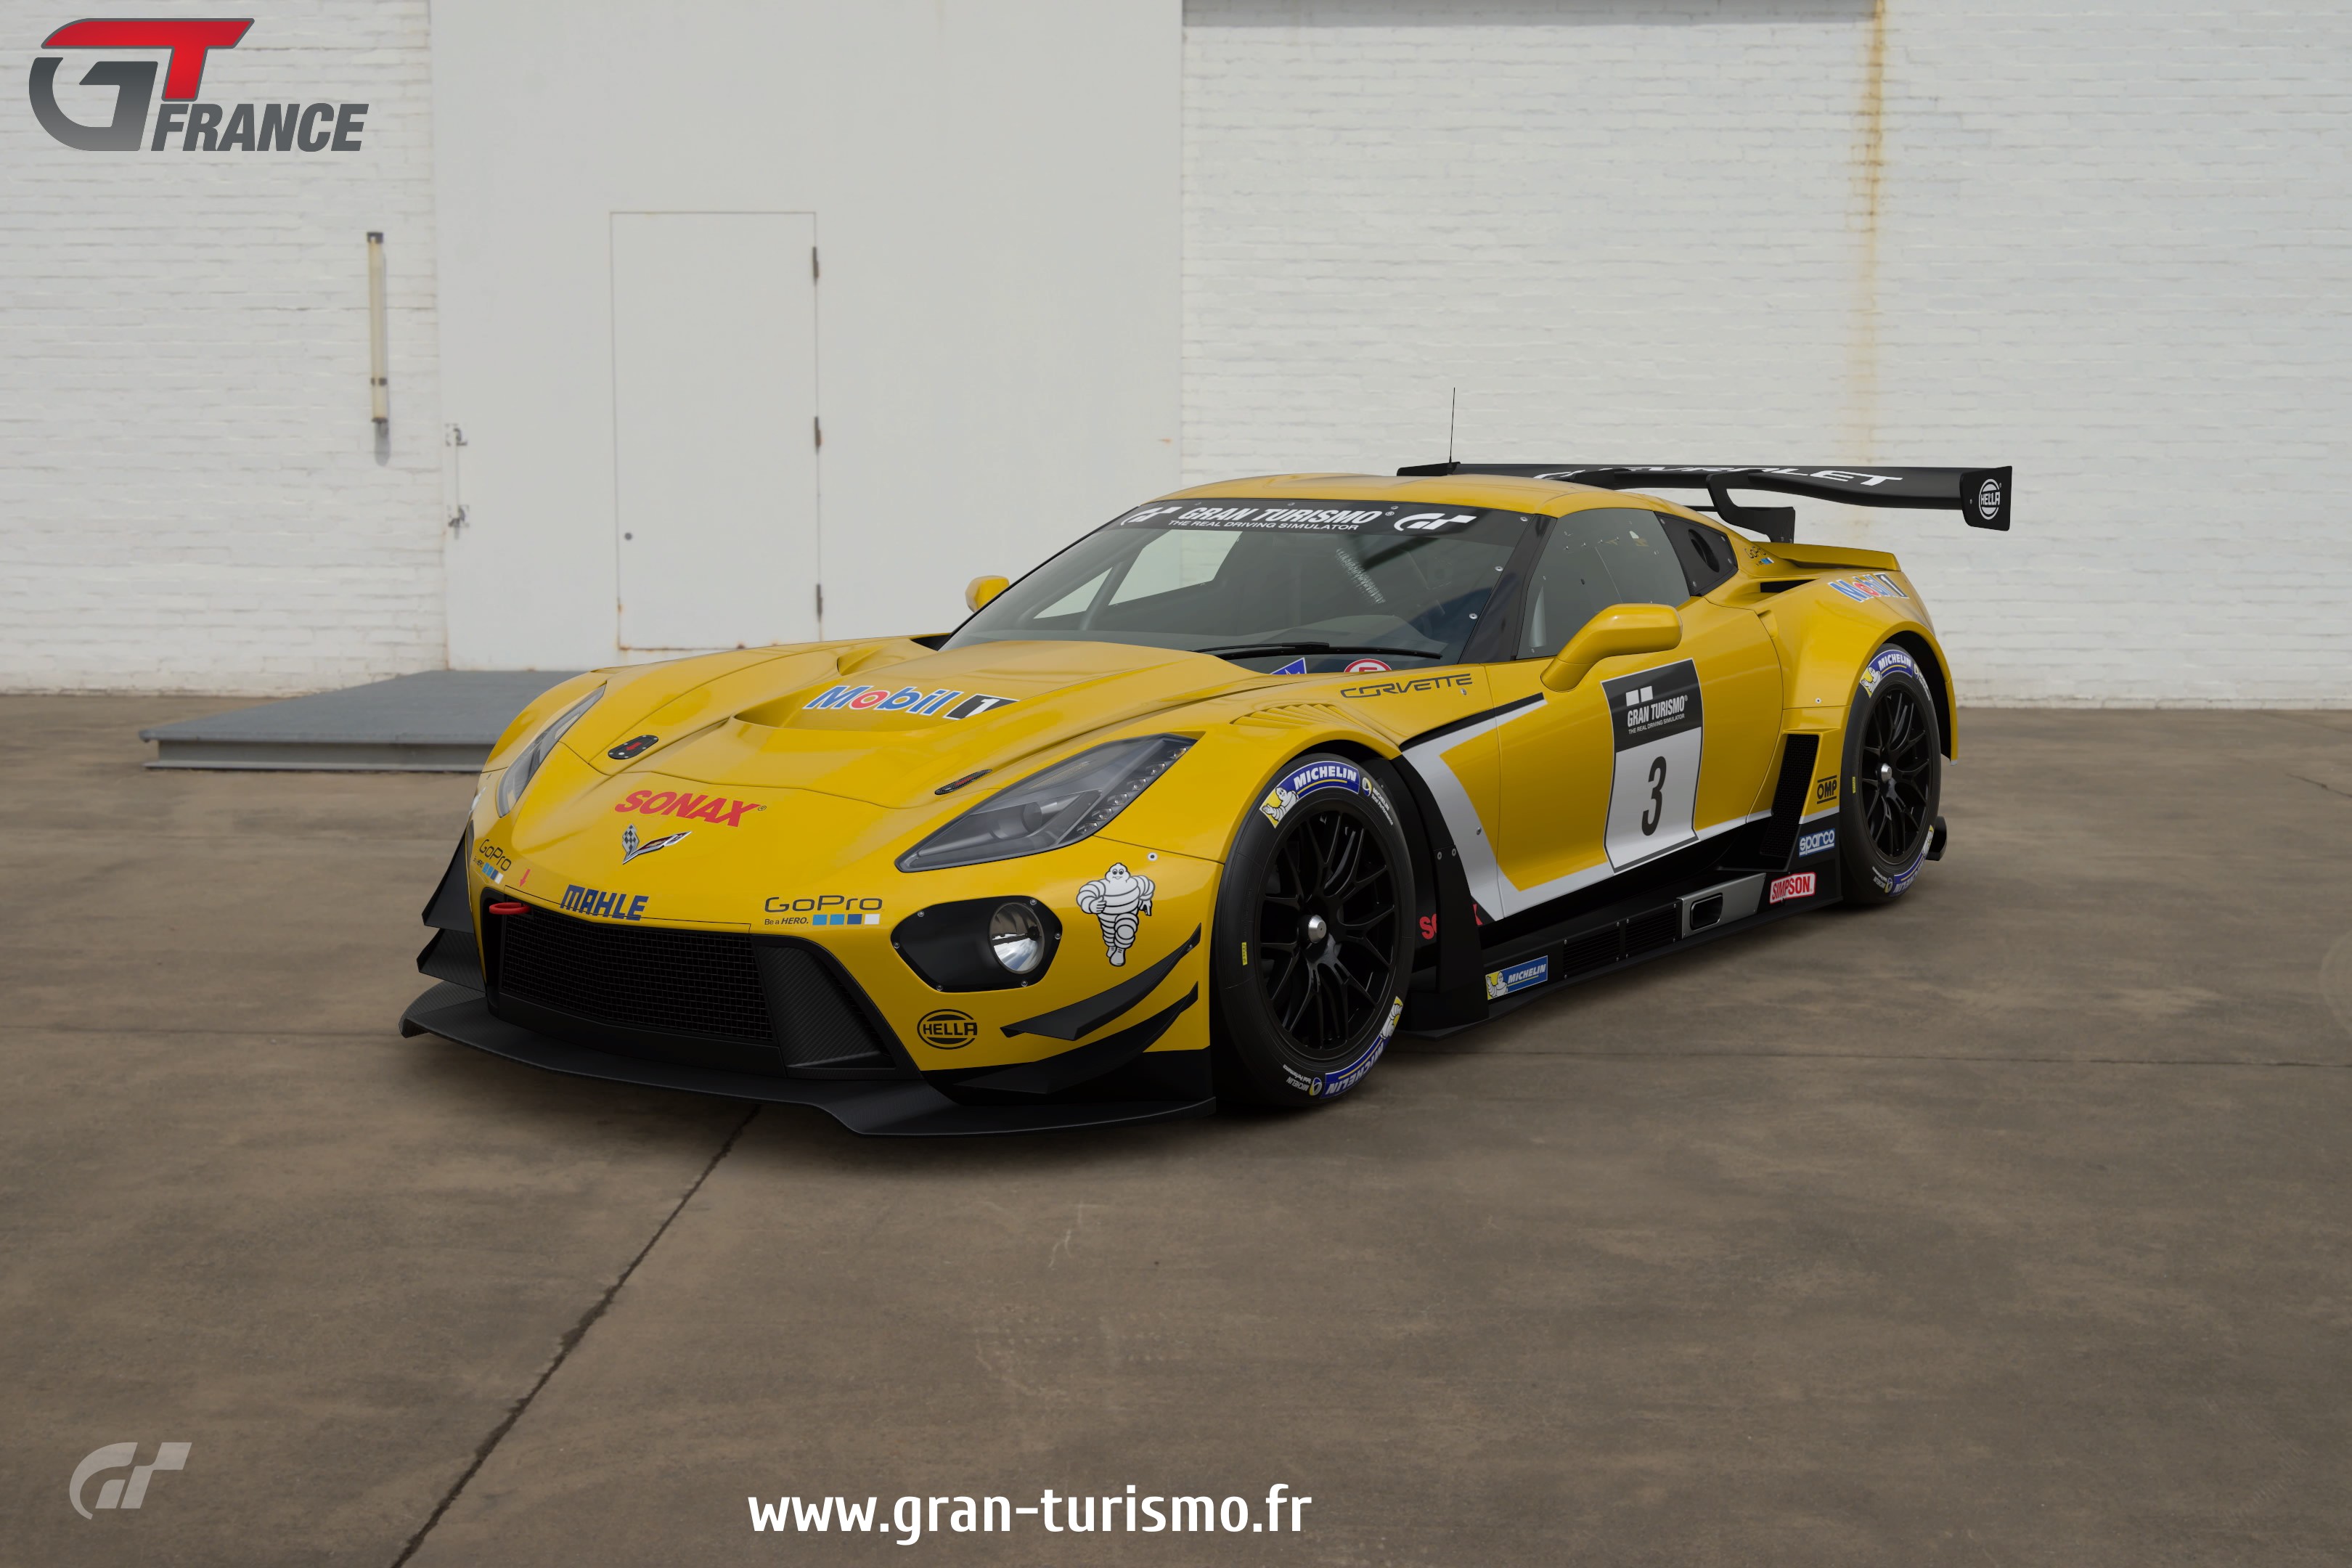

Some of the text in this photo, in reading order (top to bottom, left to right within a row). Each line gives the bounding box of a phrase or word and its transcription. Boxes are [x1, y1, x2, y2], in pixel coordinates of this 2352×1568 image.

[1980, 491, 2001, 506] HELLA
[1177, 507, 1259, 521] GRAN
[1877, 653, 1911, 671] MICHELIN
[1340, 673, 1474, 698] CORVETTE
[801, 685, 965, 716] Mobil
[1627, 706, 1649, 727] GRAN
[1647, 719, 1664, 730] DRIVING
[1663, 713, 1685, 724] SIMULATOR
[1294, 765, 1357, 790] MICHELIN
[1372, 787, 1389, 811] MICHELIN
[1641, 756, 1667, 836] 3
[1817, 780, 1837, 799] OMP
[615, 790, 761, 828] SONAX
[1800, 830, 1836, 853] sparco
[479, 838, 512, 872] GoPro
[1771, 876, 1811, 899] SIMPSON
[560, 884, 649, 921] MAHLE
[764, 894, 883, 913] GoPro
[1508, 963, 1547, 984] MICHELIN
[923, 1022, 978, 1037] HELLA
[1326, 1042, 1384, 1095] MICHELIN
